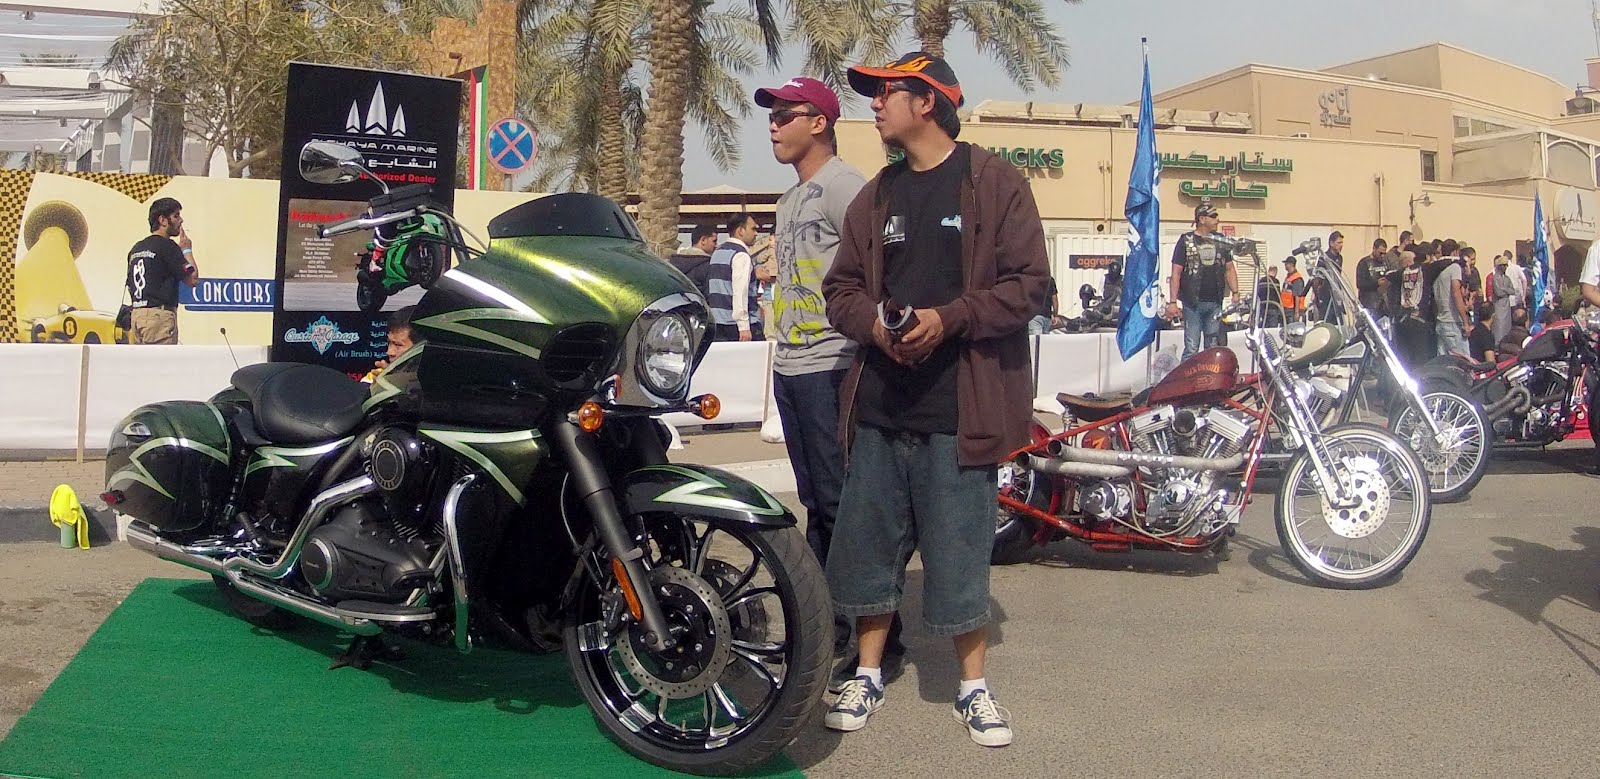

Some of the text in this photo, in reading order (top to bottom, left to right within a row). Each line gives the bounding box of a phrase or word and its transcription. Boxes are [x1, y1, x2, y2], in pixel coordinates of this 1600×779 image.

[380, 143, 437, 154] MARINE
[359, 172, 436, 184] Auhorized Dealer
[1179, 177, 1268, 201] كافيه
[1077, 256, 1117, 268] aggrek
[193, 281, 270, 303] CONCOURS
